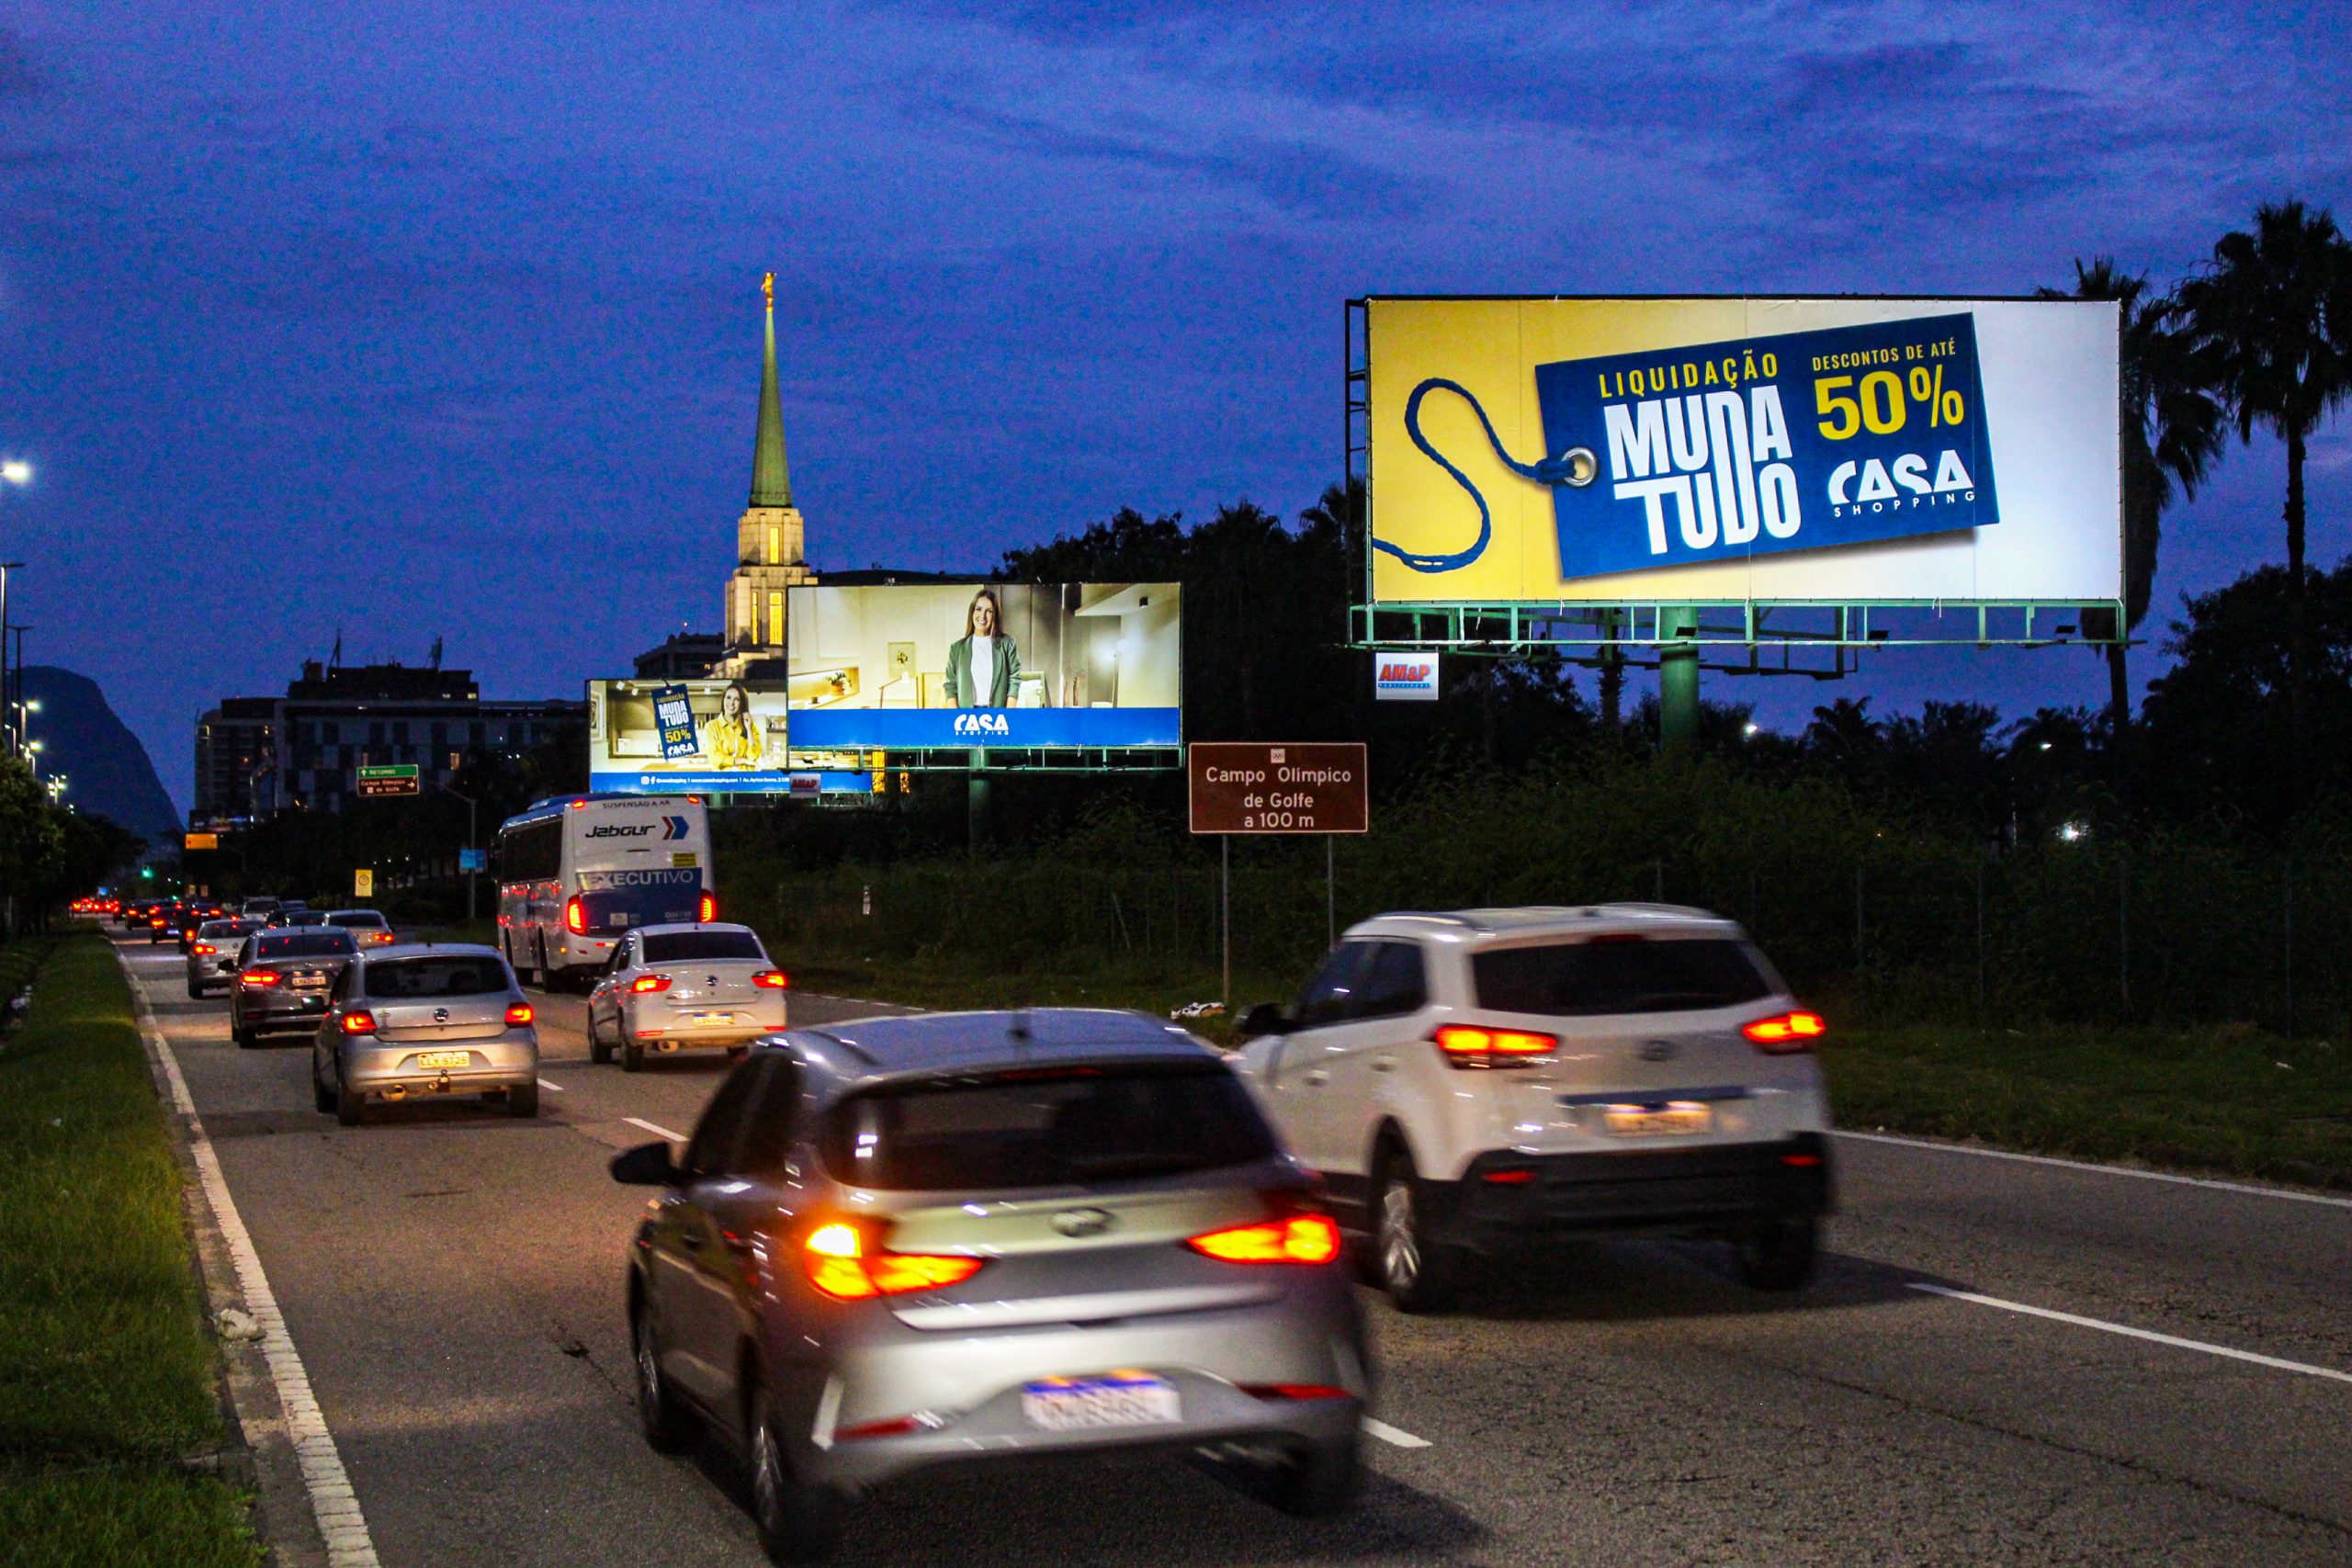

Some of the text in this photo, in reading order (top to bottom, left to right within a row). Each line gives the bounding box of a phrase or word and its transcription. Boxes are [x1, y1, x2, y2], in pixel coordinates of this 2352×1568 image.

[1813, 337, 1956, 371] DESCONTOS DE ATÉ
[1599, 349, 1779, 399] LIQUIDAÇÃO
[1815, 364, 1964, 441] 50%
[1603, 384, 1793, 480] MUDA
[1827, 449, 1974, 505] CASA
[1613, 462, 1802, 555] TUDO
[1834, 491, 1975, 518] SHOPPING
[1378, 664, 1430, 682] AM&P
[658, 700, 687, 717] MUDA
[660, 711, 690, 727] TUDO
[954, 714, 1009, 731] CASA
[665, 728, 692, 744] 50%
[667, 742, 695, 756] CASA
[1205, 766, 1351, 787] Campo Olímpico
[603, 801, 650, 809] SUSPENSÃO
[1244, 792, 1314, 808] de Golfe
[1244, 812, 1314, 828] a 100 m
[585, 825, 656, 838] Jabour
[589, 870, 694, 886] EXECUTIVO
